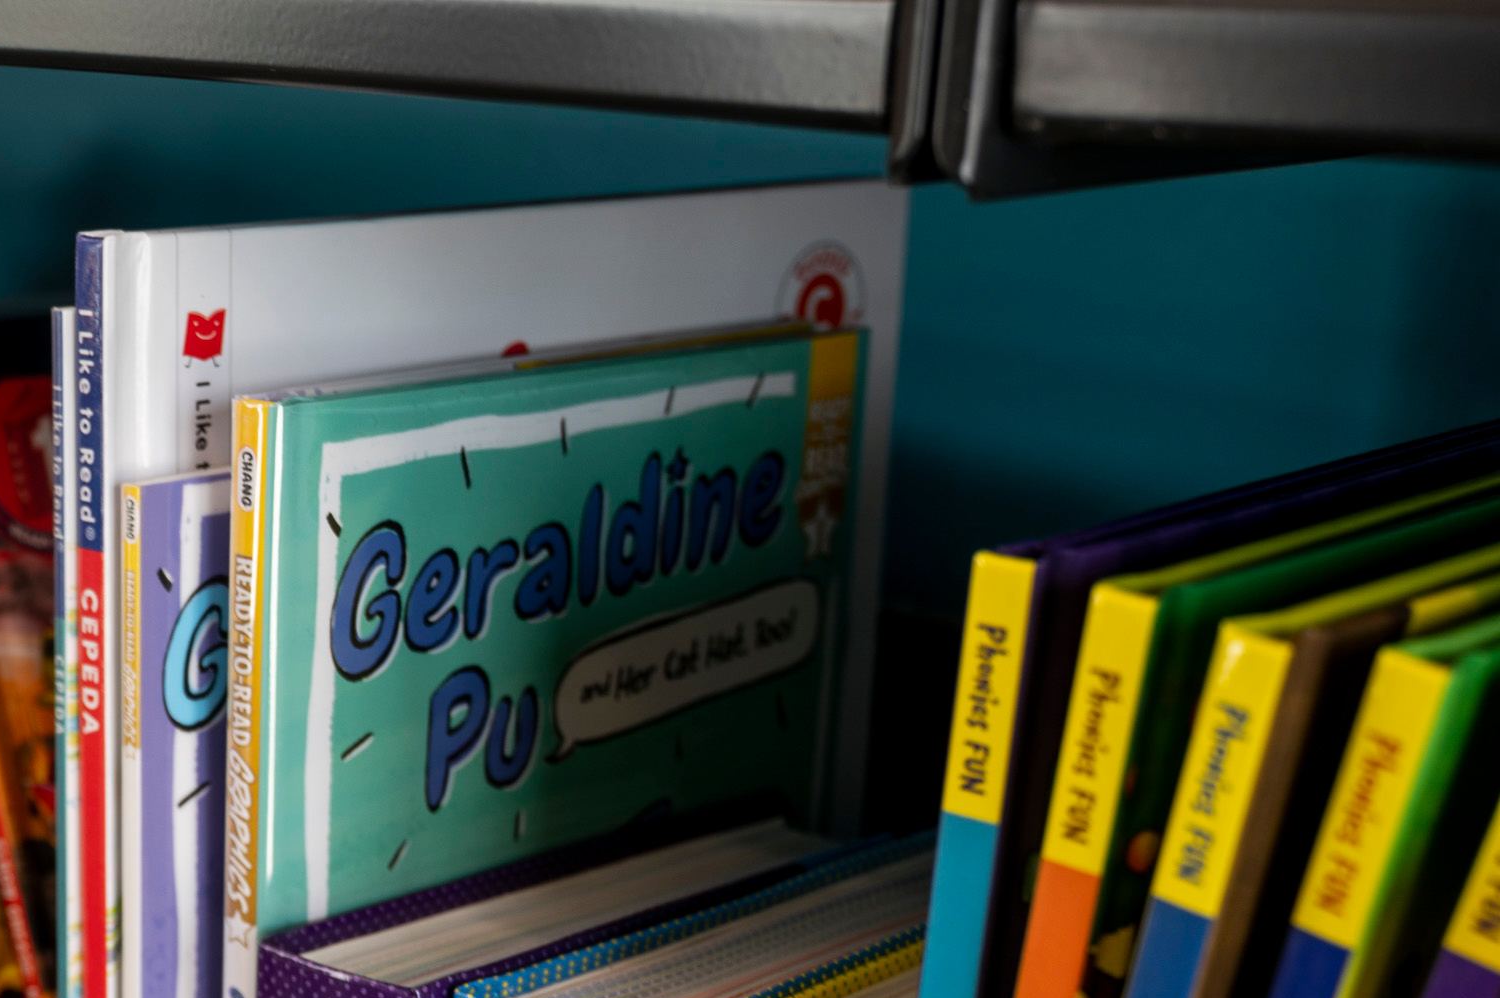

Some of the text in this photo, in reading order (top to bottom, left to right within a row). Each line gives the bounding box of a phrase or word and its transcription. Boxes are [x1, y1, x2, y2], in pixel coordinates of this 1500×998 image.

[78, 331, 95, 394] Like
[79, 407, 94, 435] to
[195, 400, 212, 450] Like
[240, 451, 253, 507] CHANG
[330, 449, 785, 682] Geraldine
[81, 588, 100, 735] CEPEDA
[228, 554, 256, 915] READY-TO-READ GRAPHICS
[426, 665, 539, 813] Pu
[958, 738, 991, 796] FUN
